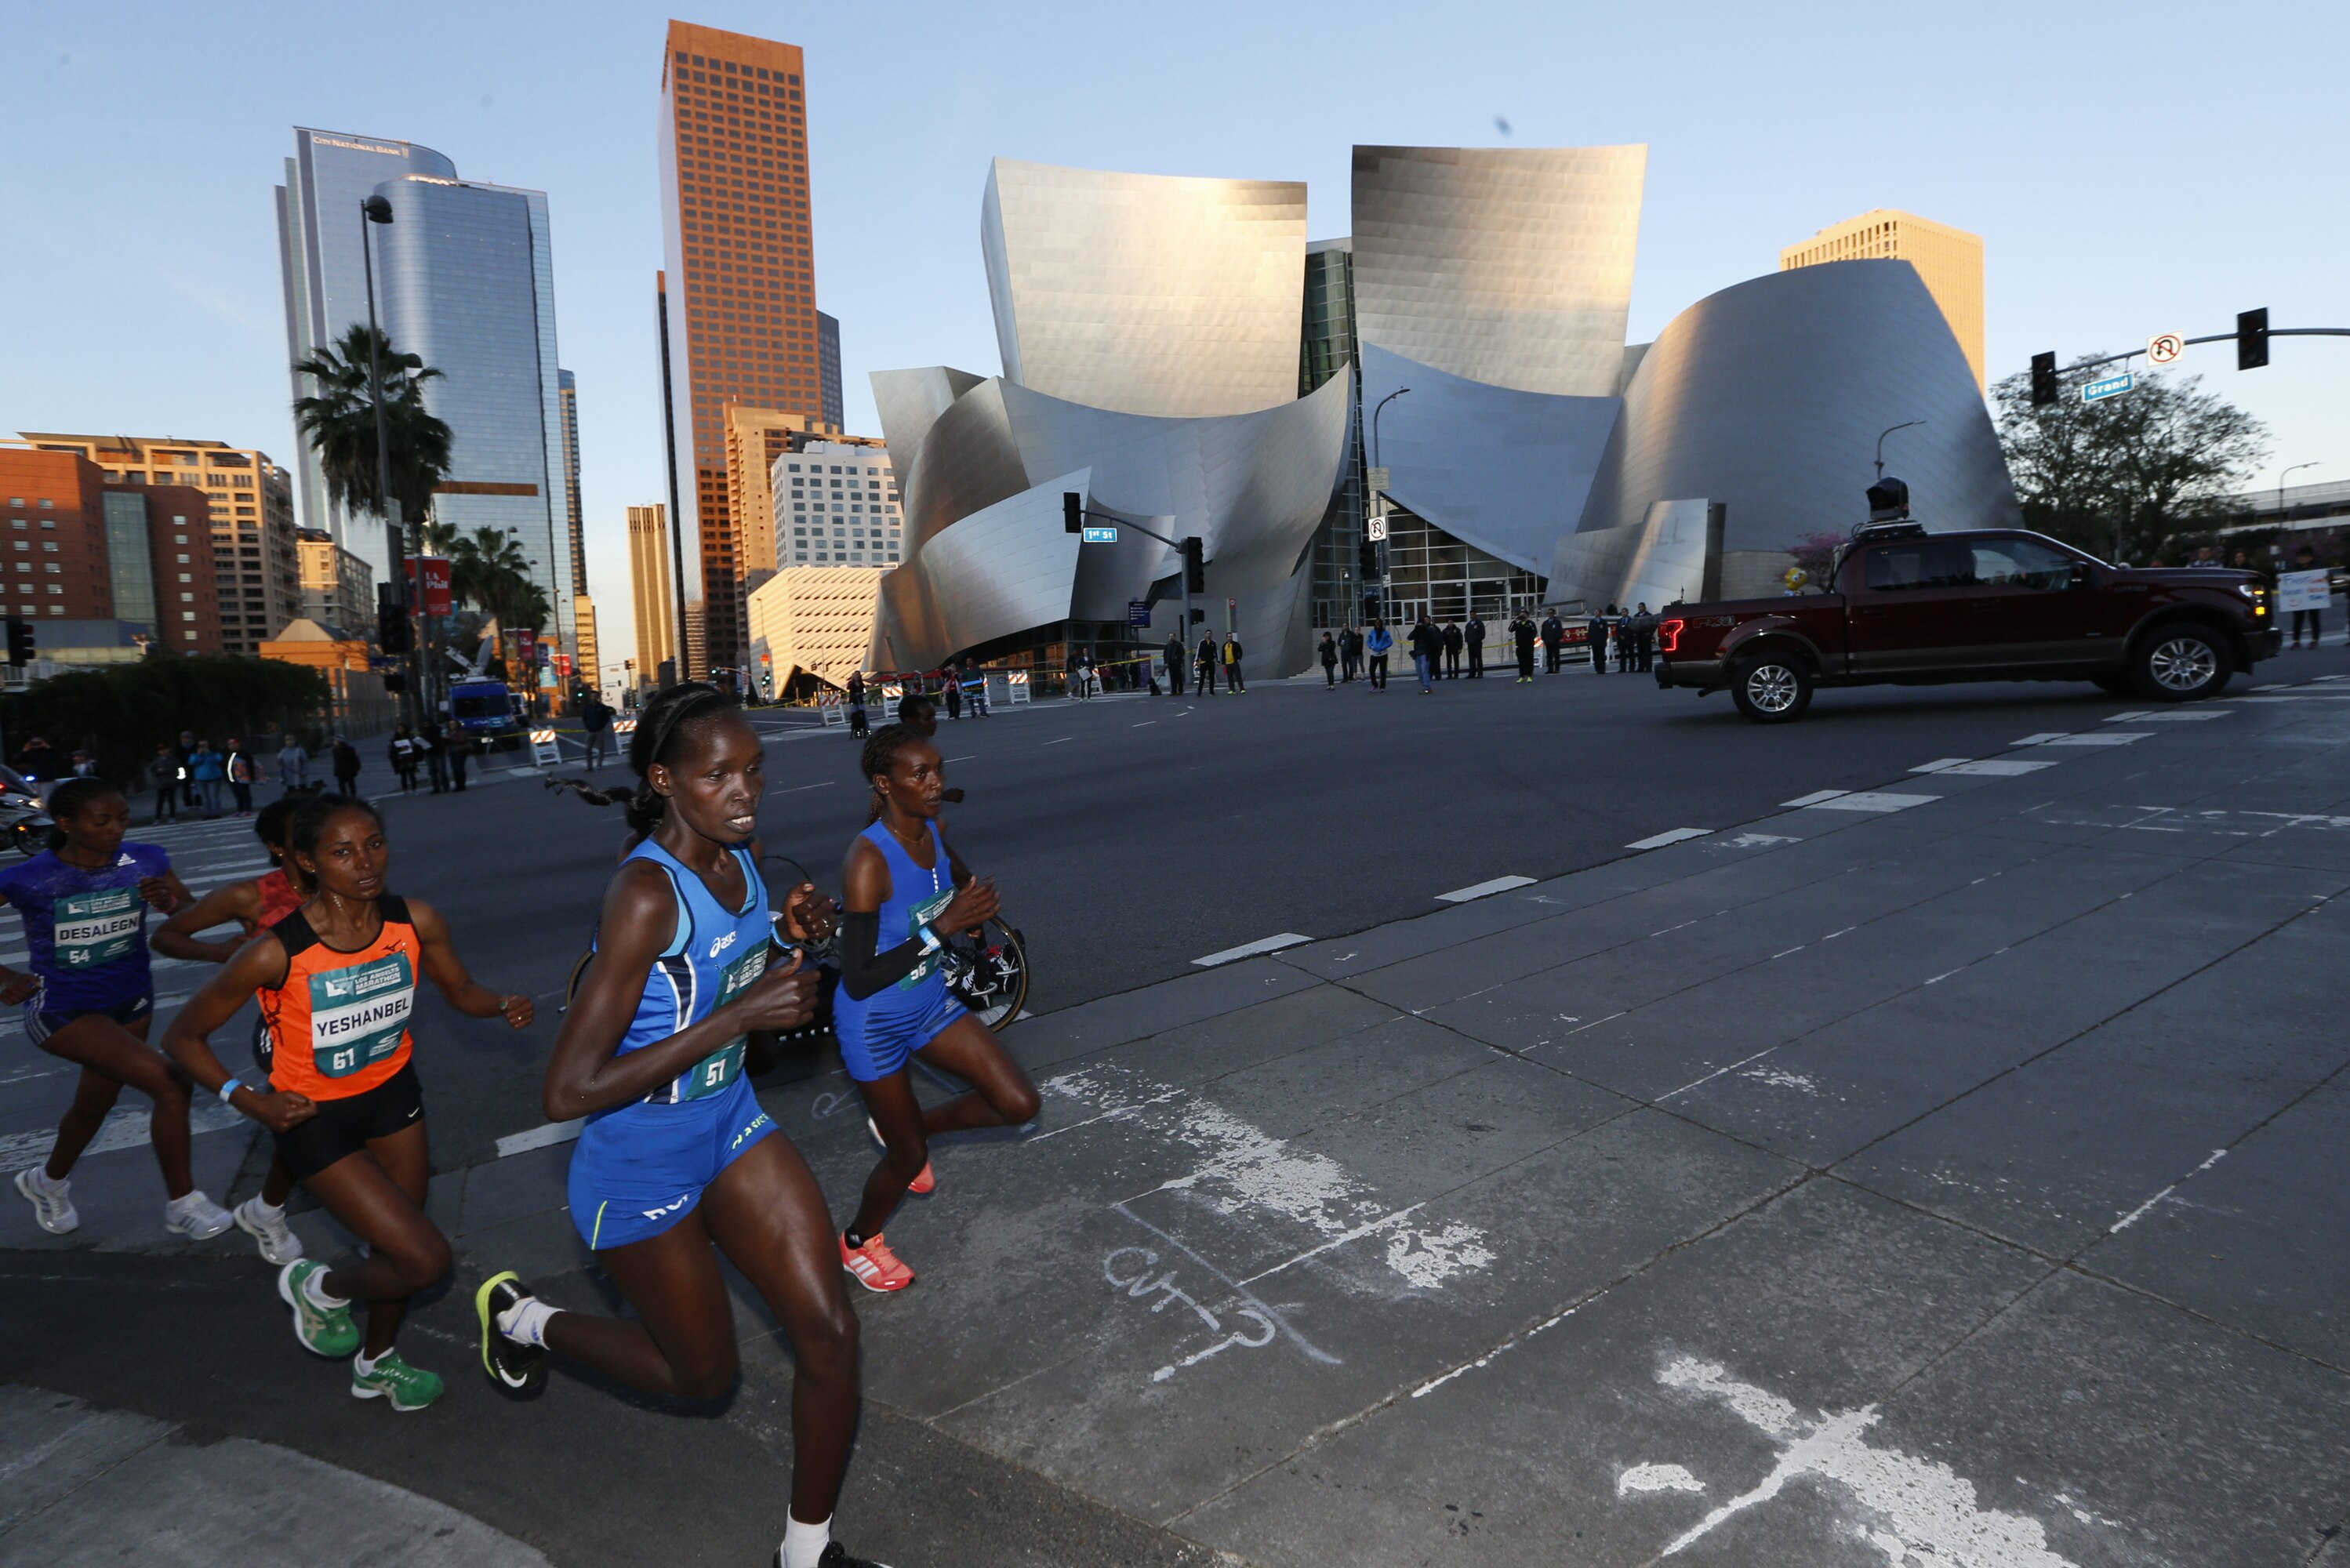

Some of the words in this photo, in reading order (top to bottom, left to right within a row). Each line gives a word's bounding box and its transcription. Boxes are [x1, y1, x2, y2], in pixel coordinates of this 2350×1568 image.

[2087, 376, 2128, 396] Grand
[1088, 530, 1099, 539] 1st
[60, 916, 138, 941] DESALEGN
[69, 948, 91, 964] 54
[354, 975, 369, 985] LOS
[369, 966, 400, 981] ANGELES
[355, 971, 401, 991] MARATHON
[317, 997, 409, 1037] YESHANBEL
[333, 1047, 354, 1070] 61
